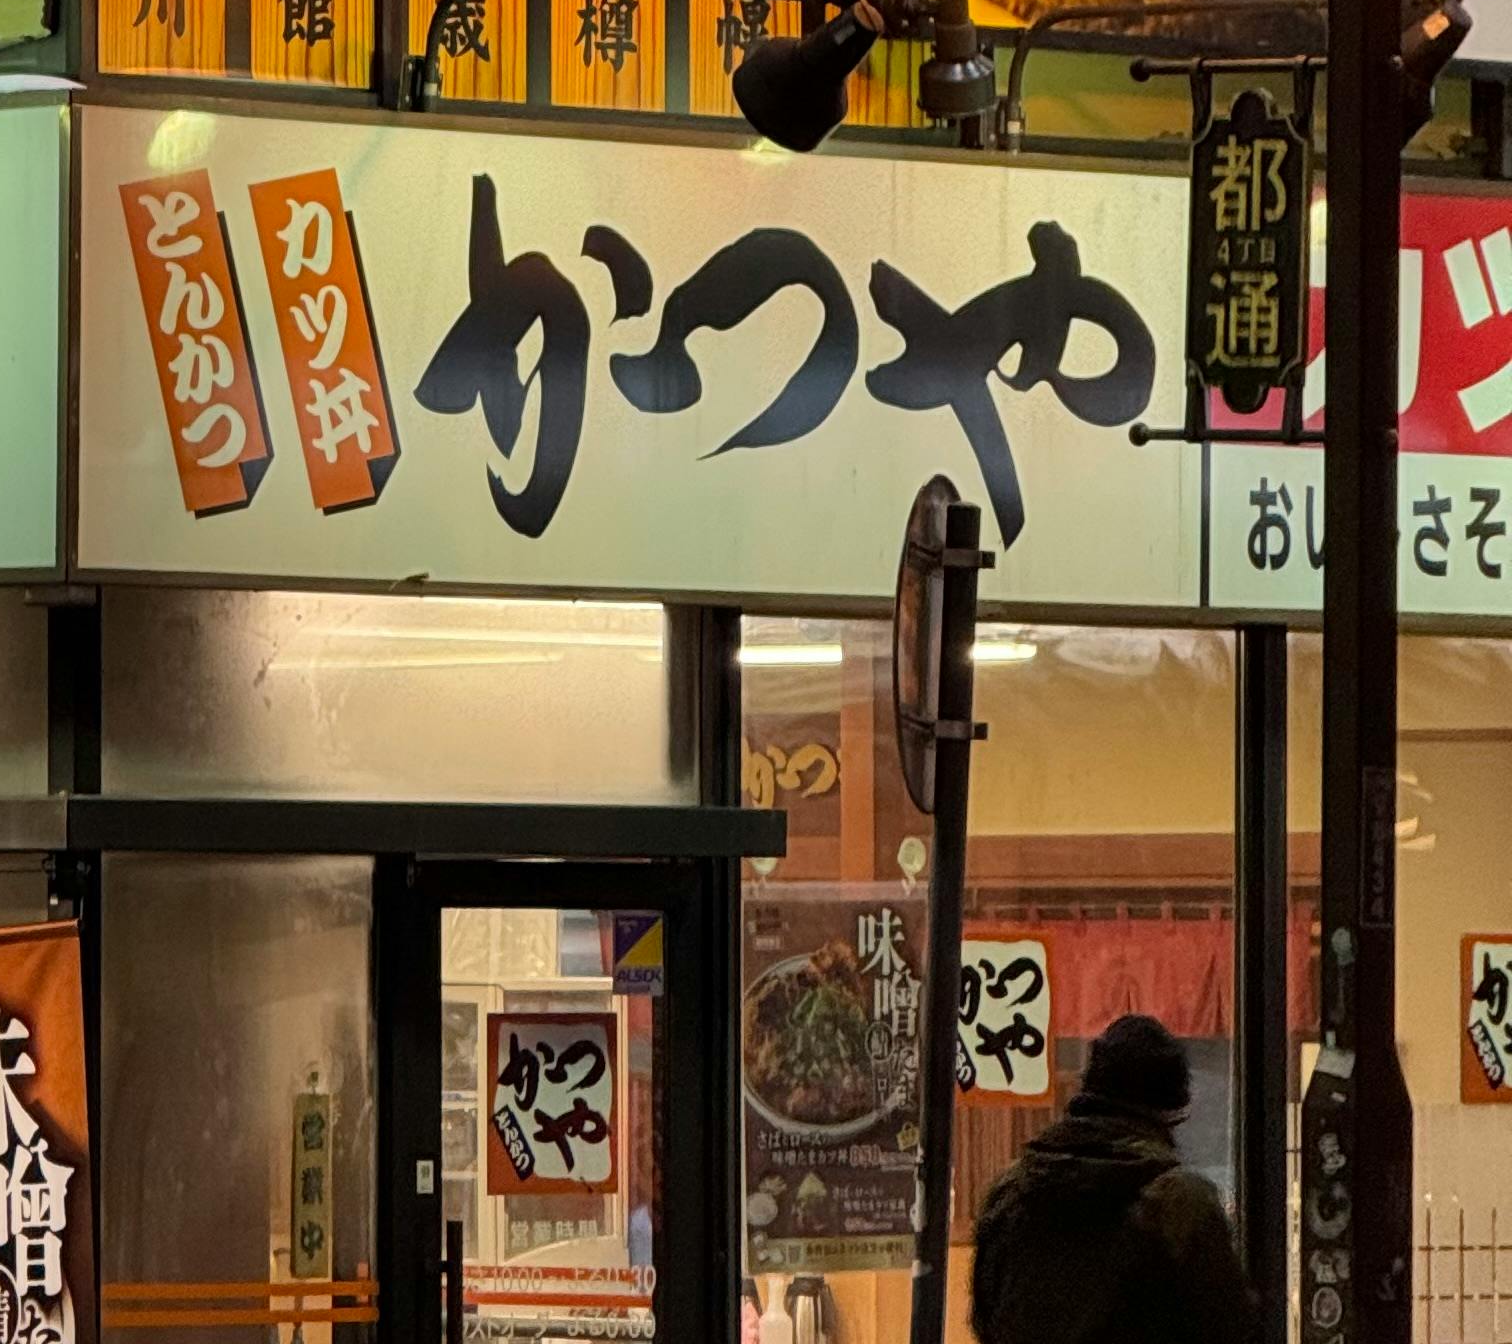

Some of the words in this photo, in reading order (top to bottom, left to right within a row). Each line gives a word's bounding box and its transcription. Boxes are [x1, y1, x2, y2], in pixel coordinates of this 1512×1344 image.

[139, 191, 247, 468] とんかつ
[277, 198, 379, 463] カツ丼
[413, 172, 1156, 552] かつや
[498, 1033, 608, 1172] かつや
